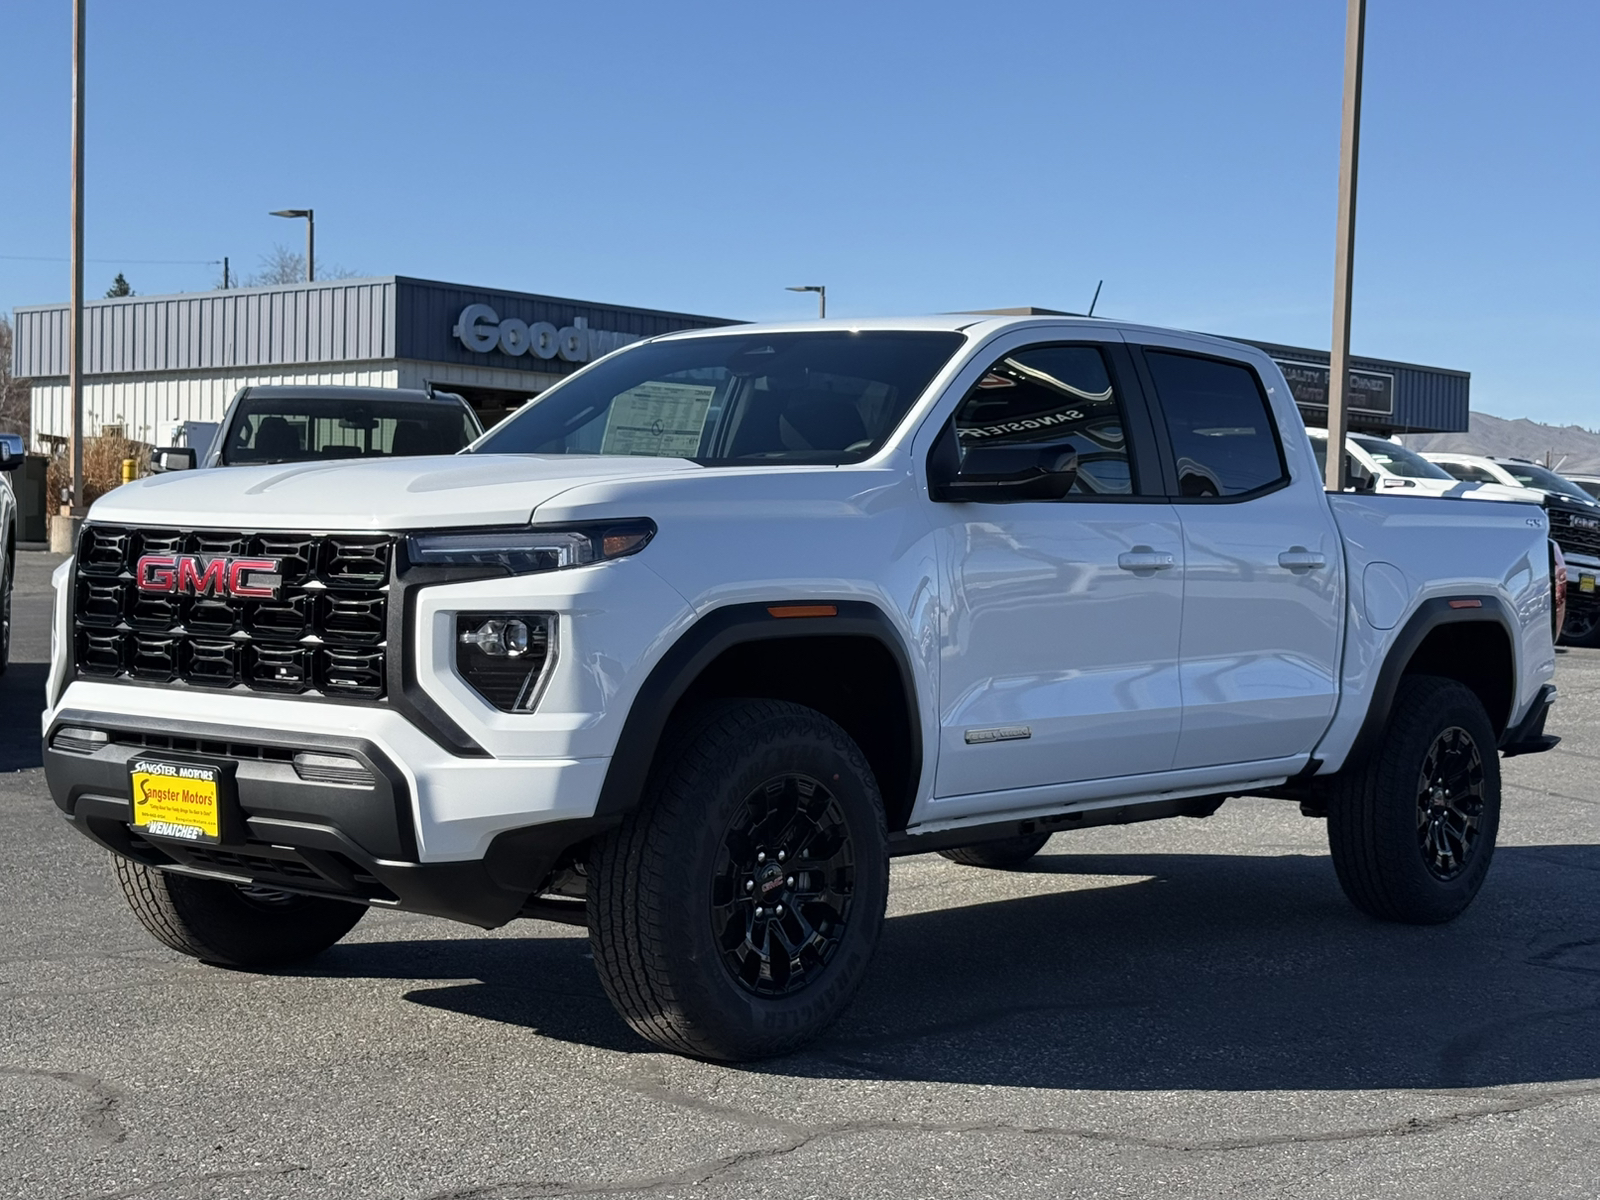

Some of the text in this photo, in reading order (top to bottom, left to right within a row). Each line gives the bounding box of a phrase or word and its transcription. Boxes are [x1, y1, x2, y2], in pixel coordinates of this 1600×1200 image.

[137, 555, 280, 598] GMC
[130, 761, 213, 781] SANGSTER MOTORS
[137, 779, 213, 806] Sangster Motors
[148, 821, 198, 840] WENATCHEE
